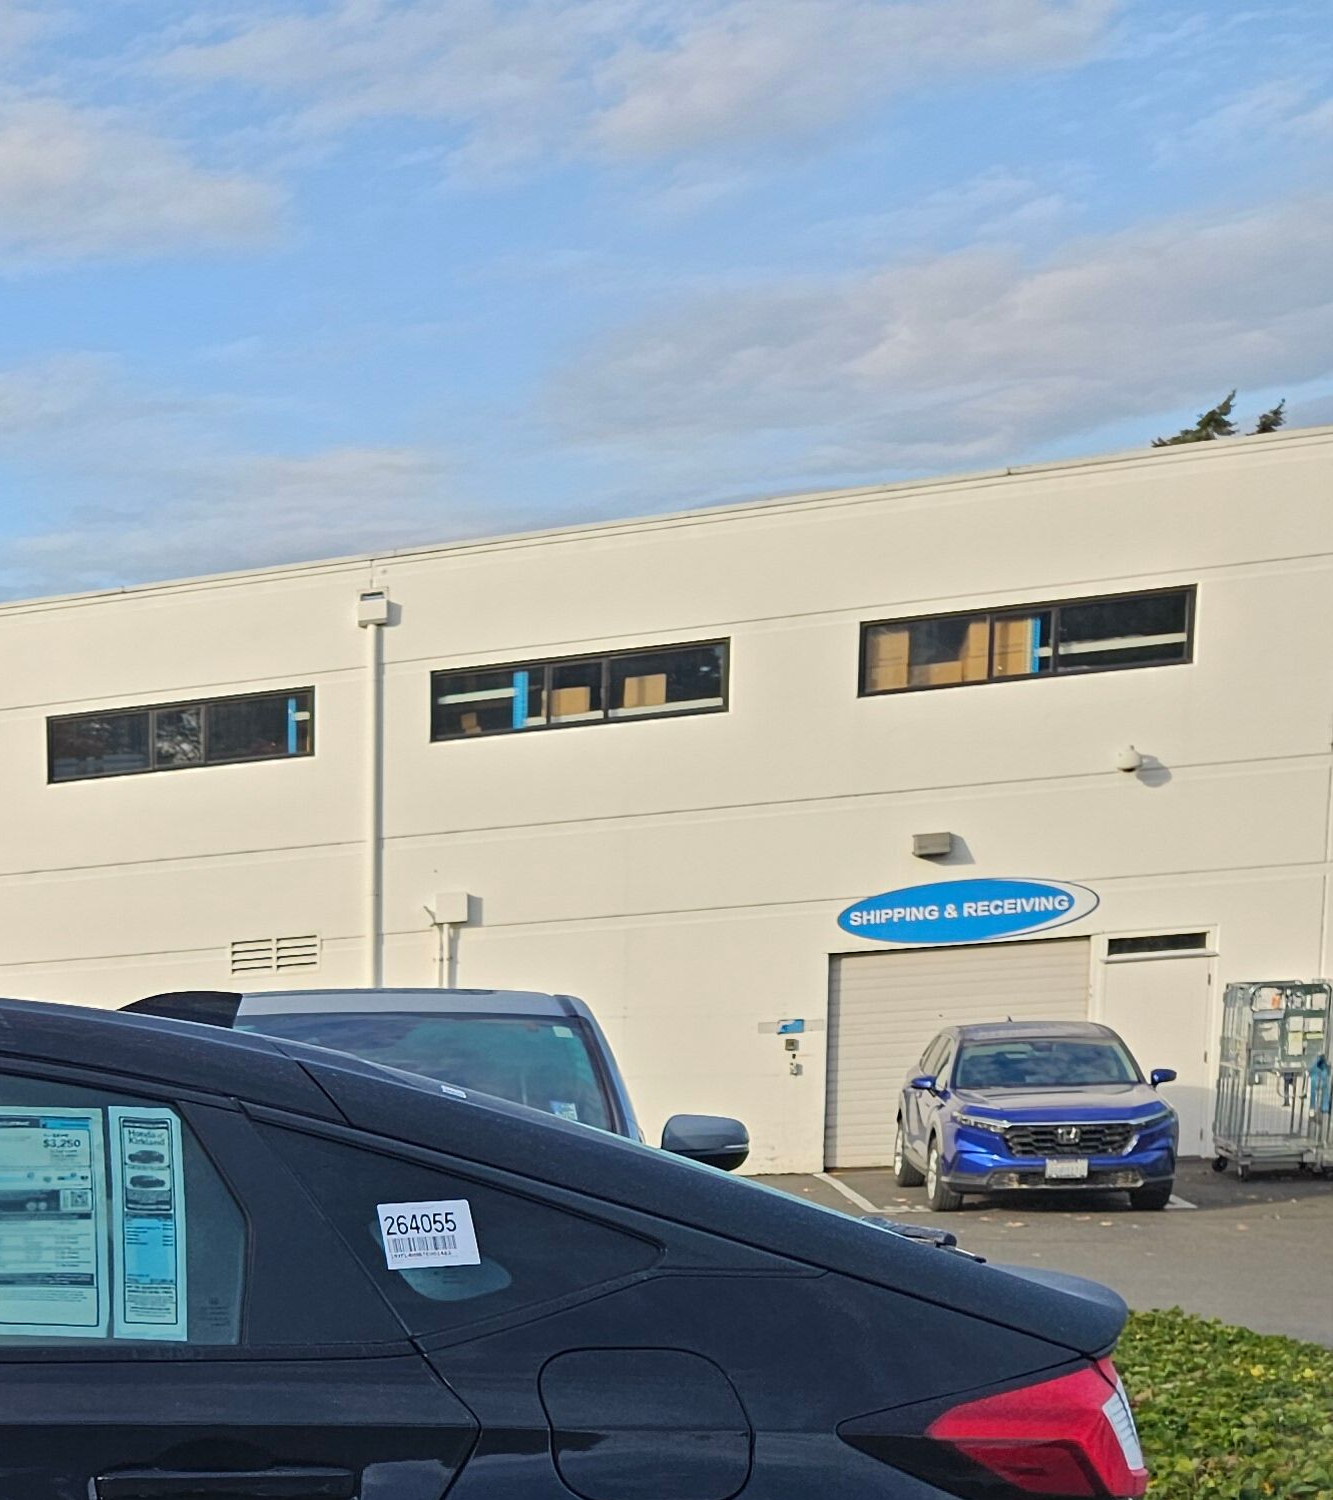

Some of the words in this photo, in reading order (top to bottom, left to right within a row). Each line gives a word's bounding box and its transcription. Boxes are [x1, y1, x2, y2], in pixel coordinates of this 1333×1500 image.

[849, 904, 939, 926] SHIPPING
[943, 904, 958, 919] &
[962, 895, 1070, 917] RECEIVING
[128, 1129, 156, 1138] Honda
[43, 1138, 81, 1149] $3,250
[384, 1212, 457, 1236] 264055
